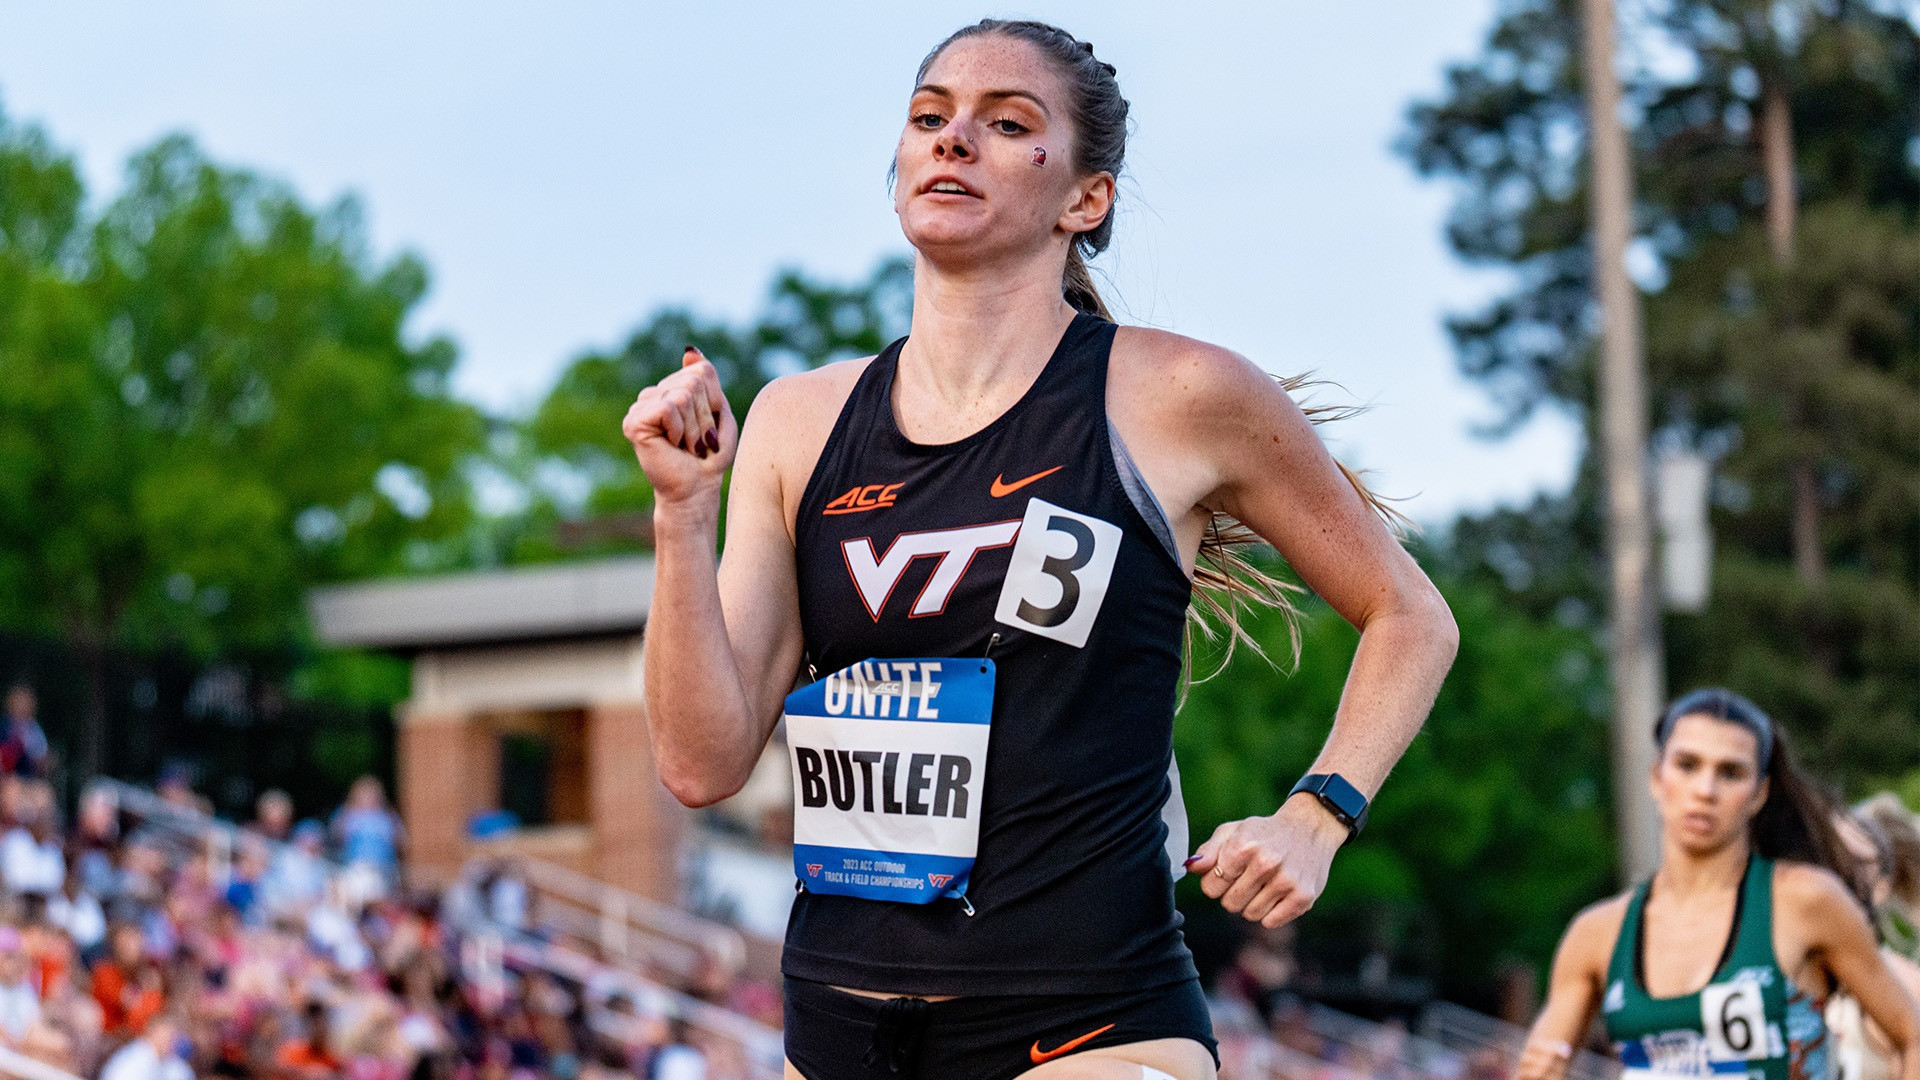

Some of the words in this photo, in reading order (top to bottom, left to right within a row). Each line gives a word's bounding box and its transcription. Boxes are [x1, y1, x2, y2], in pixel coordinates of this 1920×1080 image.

[840, 518, 1023, 623] VT
[1015, 515, 1096, 628] 3
[824, 661, 942, 719] UNITE
[795, 747, 972, 819] BUTLER
[806, 863, 823, 877] VT
[824, 871, 843, 883] TRACK
[851, 874, 869, 885] FIELD
[870, 874, 925, 890] CHAMPIONSHIPS
[843, 859, 858, 870] 2023
[860, 860, 873, 871] ACC
[873, 860, 906, 874] OUTDOOR
[928, 873, 954, 888] VT
[1721, 992, 1752, 1052] 6
